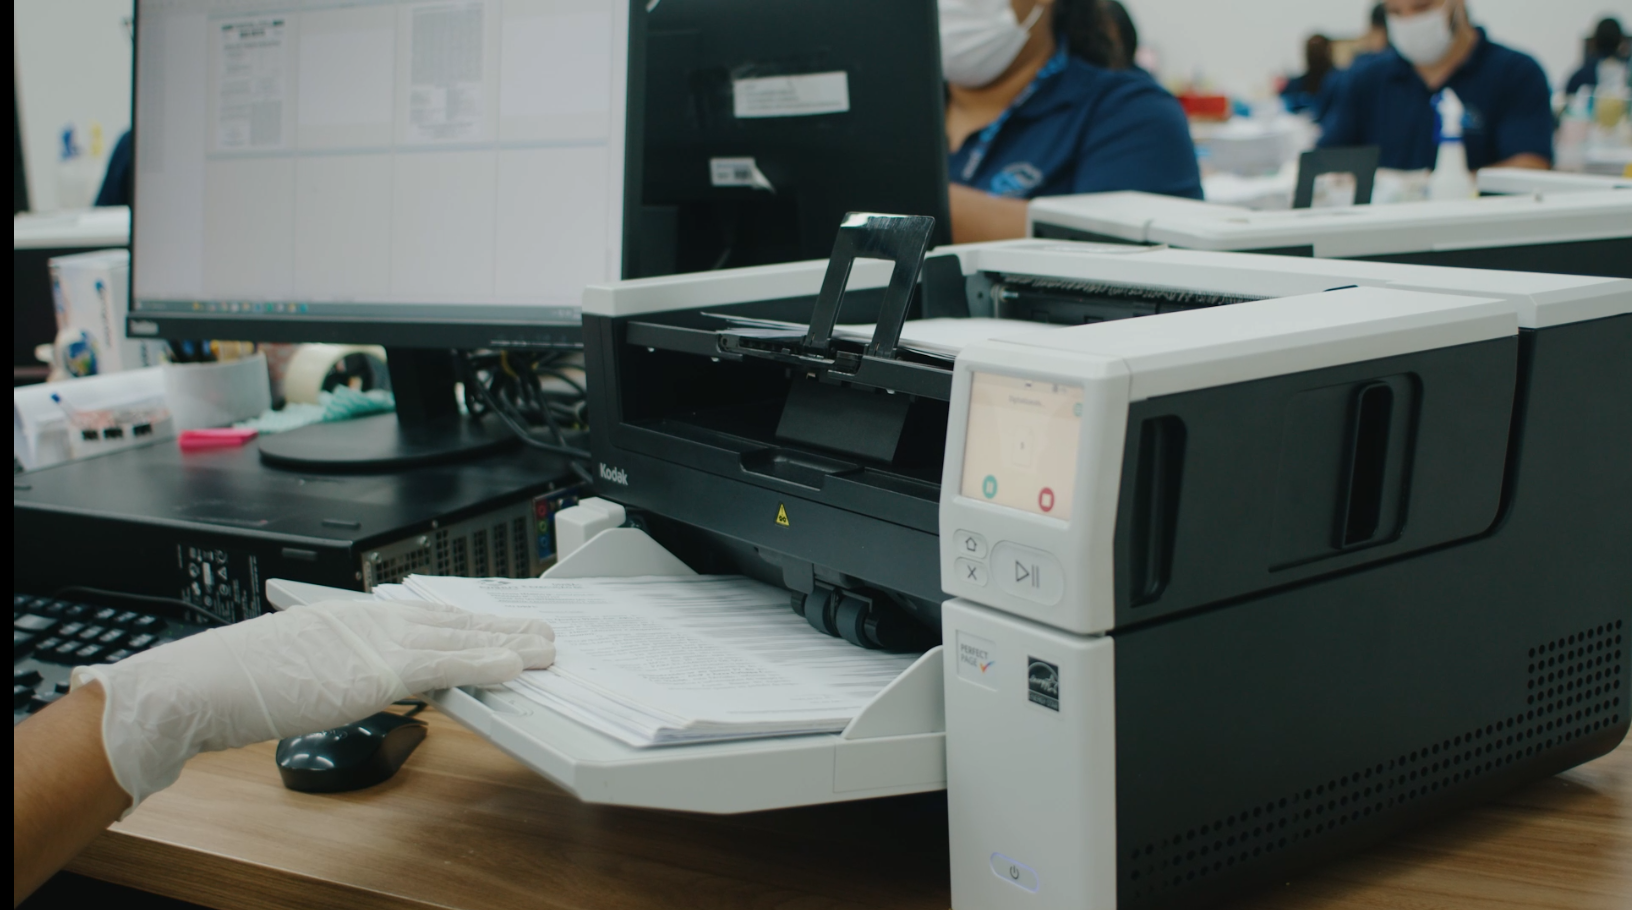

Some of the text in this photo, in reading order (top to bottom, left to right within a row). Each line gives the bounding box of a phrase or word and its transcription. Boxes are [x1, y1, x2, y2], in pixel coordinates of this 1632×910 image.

[600, 462, 628, 485] Kodak
[960, 643, 988, 660] PERFECT
[960, 653, 978, 667] PAGE
